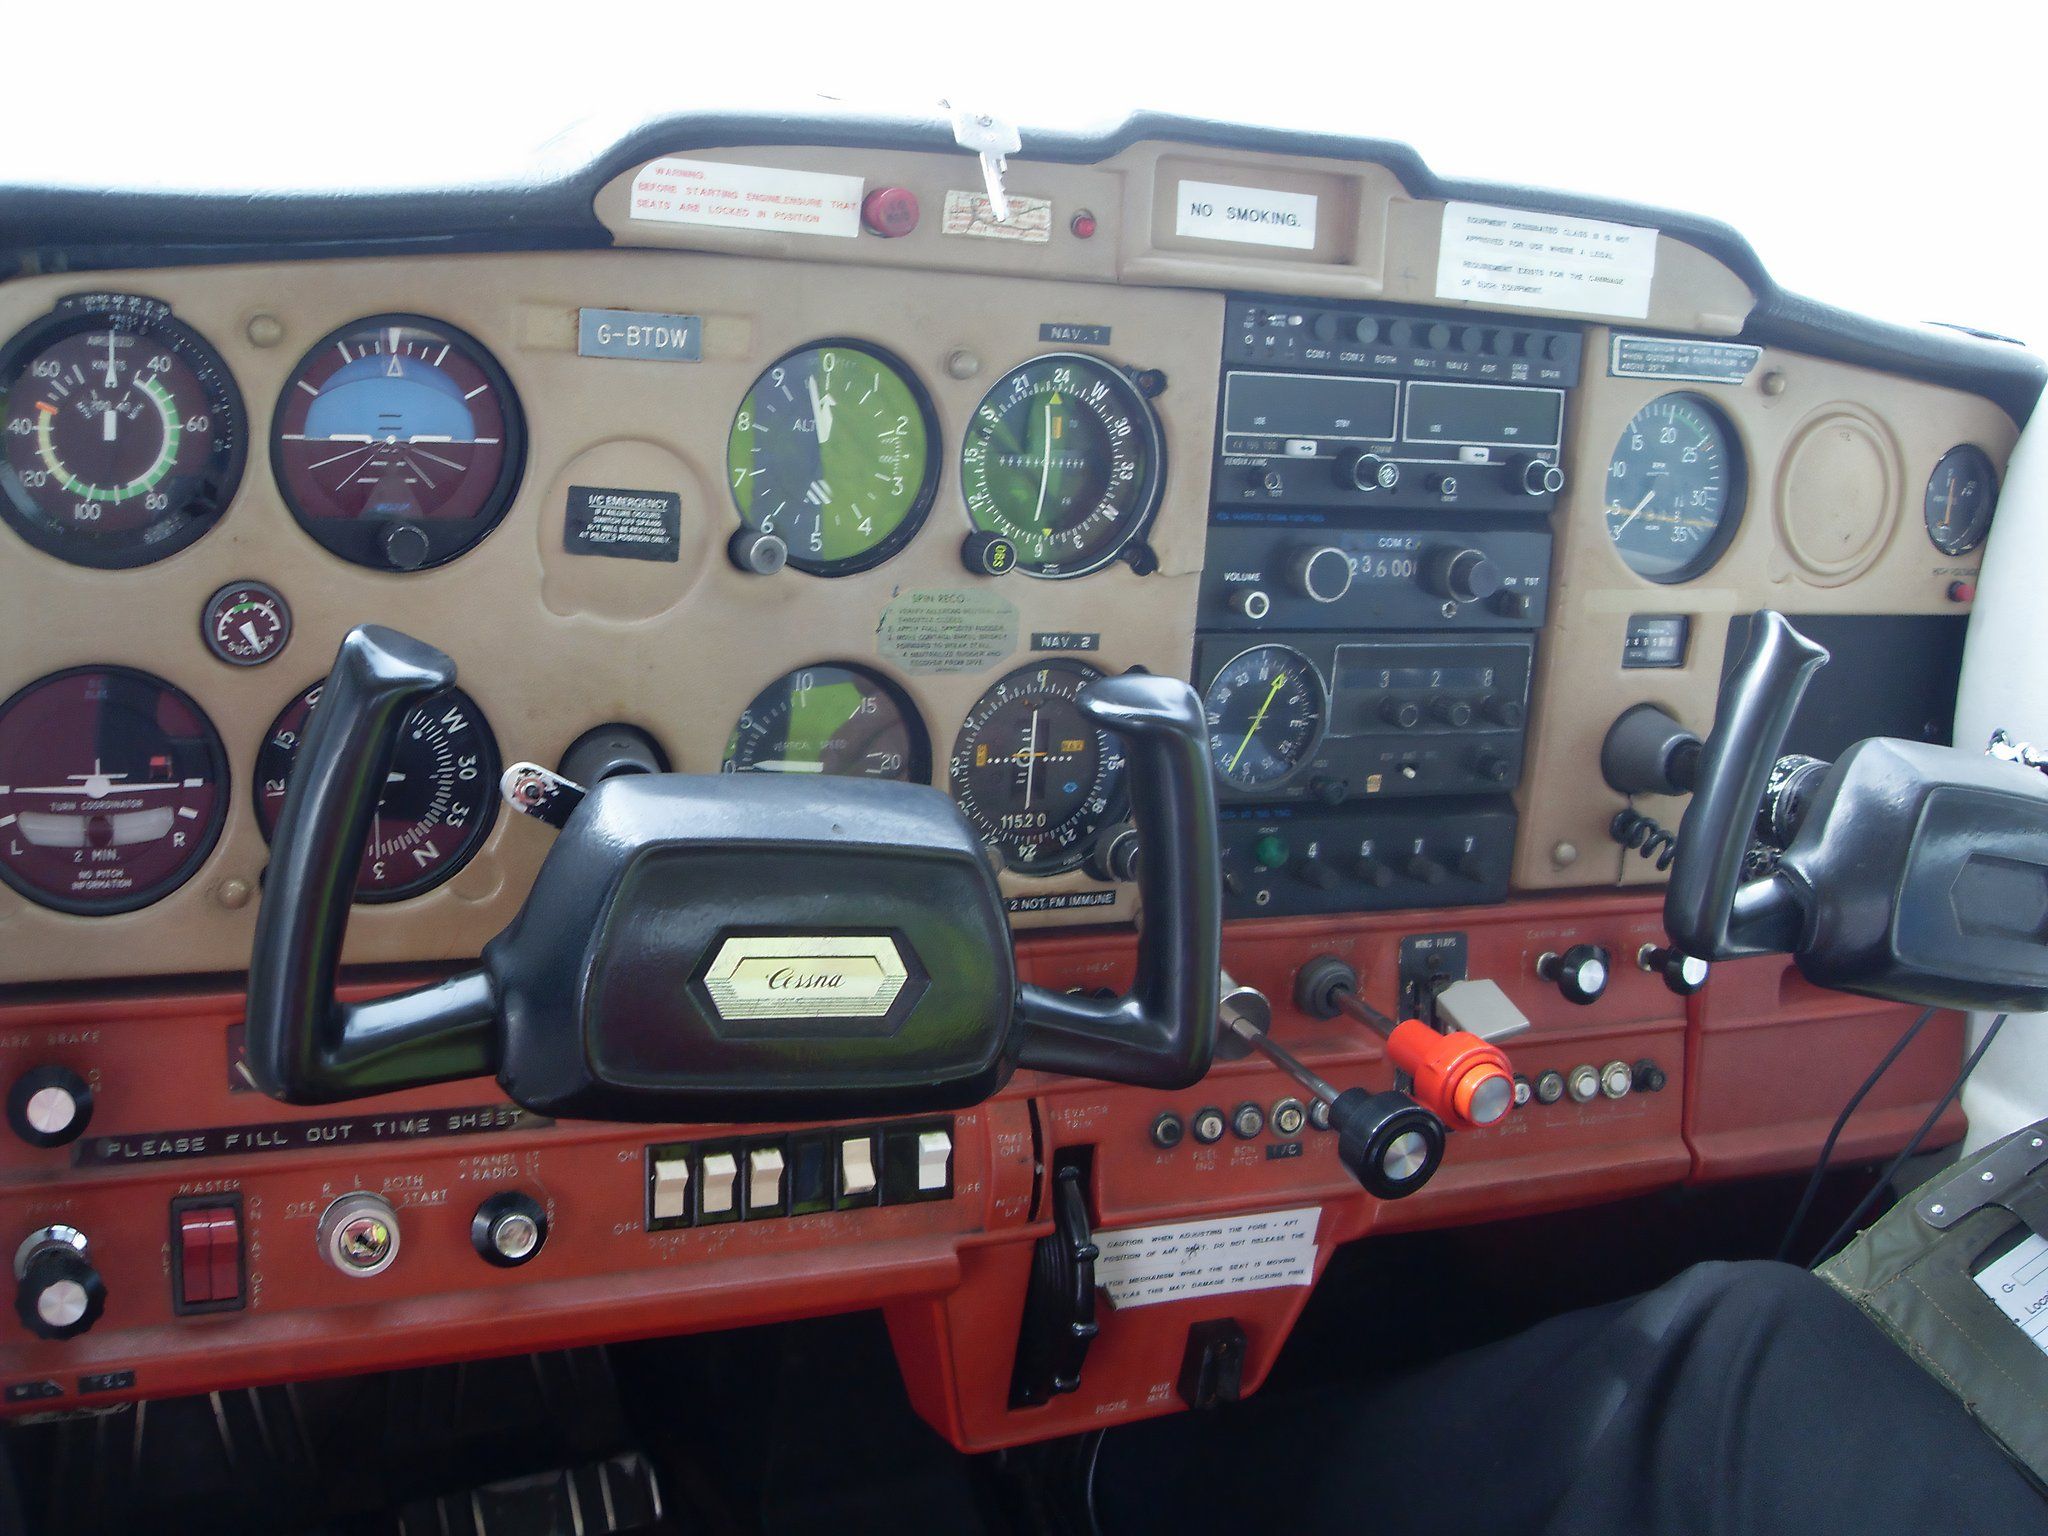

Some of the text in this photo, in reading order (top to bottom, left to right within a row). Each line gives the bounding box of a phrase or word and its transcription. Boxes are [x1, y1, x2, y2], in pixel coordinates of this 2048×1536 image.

[1191, 202, 1301, 227] NO SMOKING.
[597, 323, 688, 349] G-BTDW
[147, 355, 172, 373] 40
[822, 352, 836, 372] 0
[772, 367, 786, 388] 9
[1012, 373, 1031, 392] 21
[1053, 367, 1072, 384] 24
[1092, 380, 1111, 401] W
[186, 415, 209, 432] 60
[737, 411, 750, 431] 8
[895, 415, 909, 436] 2
[1114, 416, 1132, 438] 30
[1631, 434, 1644, 451] 15
[1660, 427, 1677, 444] 20
[1681, 446, 1698, 464] 25
[734, 467, 748, 488] 7
[1612, 461, 1627, 478] 10
[891, 476, 904, 496] 3
[145, 493, 169, 510] 80
[1690, 490, 1708, 507] 30
[74, 503, 101, 520] 100
[760, 514, 774, 533] 6
[857, 516, 873, 536] 4
[809, 532, 823, 551] 5
[1378, 537, 1413, 549] COM 2
[1670, 526, 1688, 542] 35
[1224, 572, 1261, 583] VOLUME
[795, 672, 814, 692] 10
[1431, 670, 1441, 689] 2
[860, 697, 877, 715] 15
[440, 705, 469, 735] W
[740, 709, 753, 730] 5
[272, 729, 297, 751] 15
[457, 754, 478, 781] 30
[881, 754, 901, 771] 20
[446, 801, 471, 829] 33
[10, 839, 23, 856] L
[173, 831, 186, 848] R
[74, 850, 83, 863] 2
[412, 841, 440, 868] N
[372, 861, 386, 881] 3
[1010, 893, 1113, 911] 2 NOT FM IMMUNE
[768, 967, 845, 990] Cessna
[105, 1110, 522, 1159] PLEASE FILL OUT TIME SHEET
[472, 1165, 519, 1181] RADIO
[178, 1179, 241, 1194] MASTER
[402, 1189, 448, 1203] START
[1228, 1225, 1243, 1233] THE
